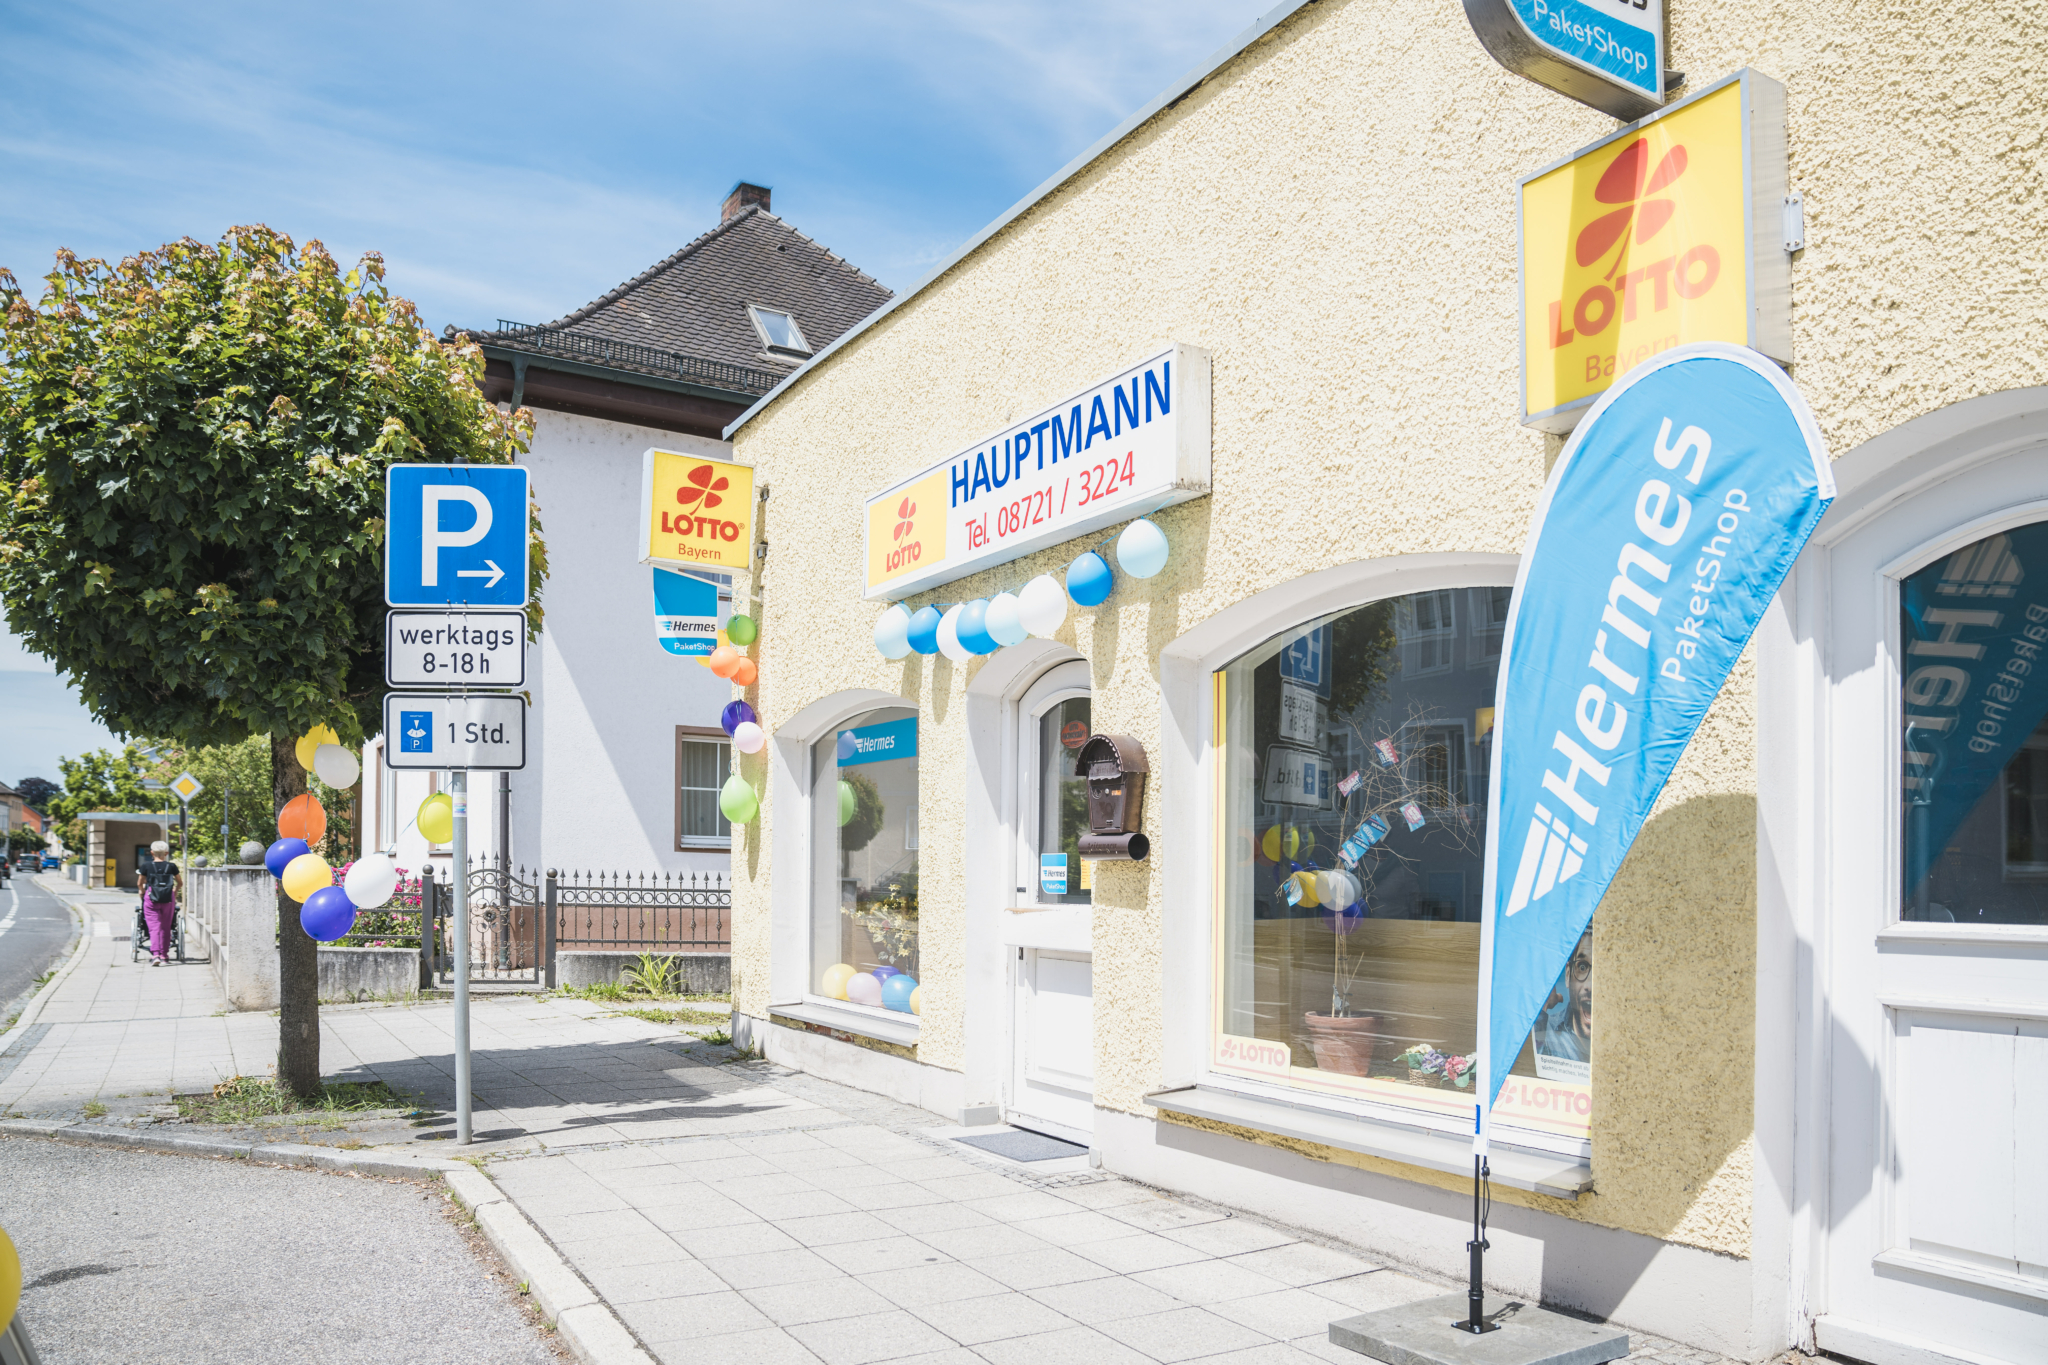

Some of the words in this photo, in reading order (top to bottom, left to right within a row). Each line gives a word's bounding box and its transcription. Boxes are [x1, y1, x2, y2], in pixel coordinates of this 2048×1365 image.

[1534, 0, 1648, 74] PaketShop
[1549, 244, 1721, 350] LOTTO
[951, 360, 1171, 508] HAUPTMANN
[965, 512, 990, 551] Tel.
[997, 485, 1053, 538] 08721
[1060, 477, 1070, 515] /
[1078, 450, 1135, 507] 3224
[421, 484, 493, 587] P
[677, 543, 721, 560] Bayern
[886, 541, 921, 573] LOTTO
[1660, 488, 1748, 683] PaketShop
[399, 623, 514, 651] werktags
[673, 620, 716, 633] Hermes
[1541, 416, 1712, 826] Hermes
[673, 642, 716, 652] PaketShop
[448, 722, 455, 743] 1
[465, 722, 510, 744] Std.
[863, 735, 895, 753] Hermes
[1047, 869, 1066, 878] Hermes
[1239, 1043, 1286, 1067] LOTTO
[1521, 1084, 1592, 1116] LOTTO
